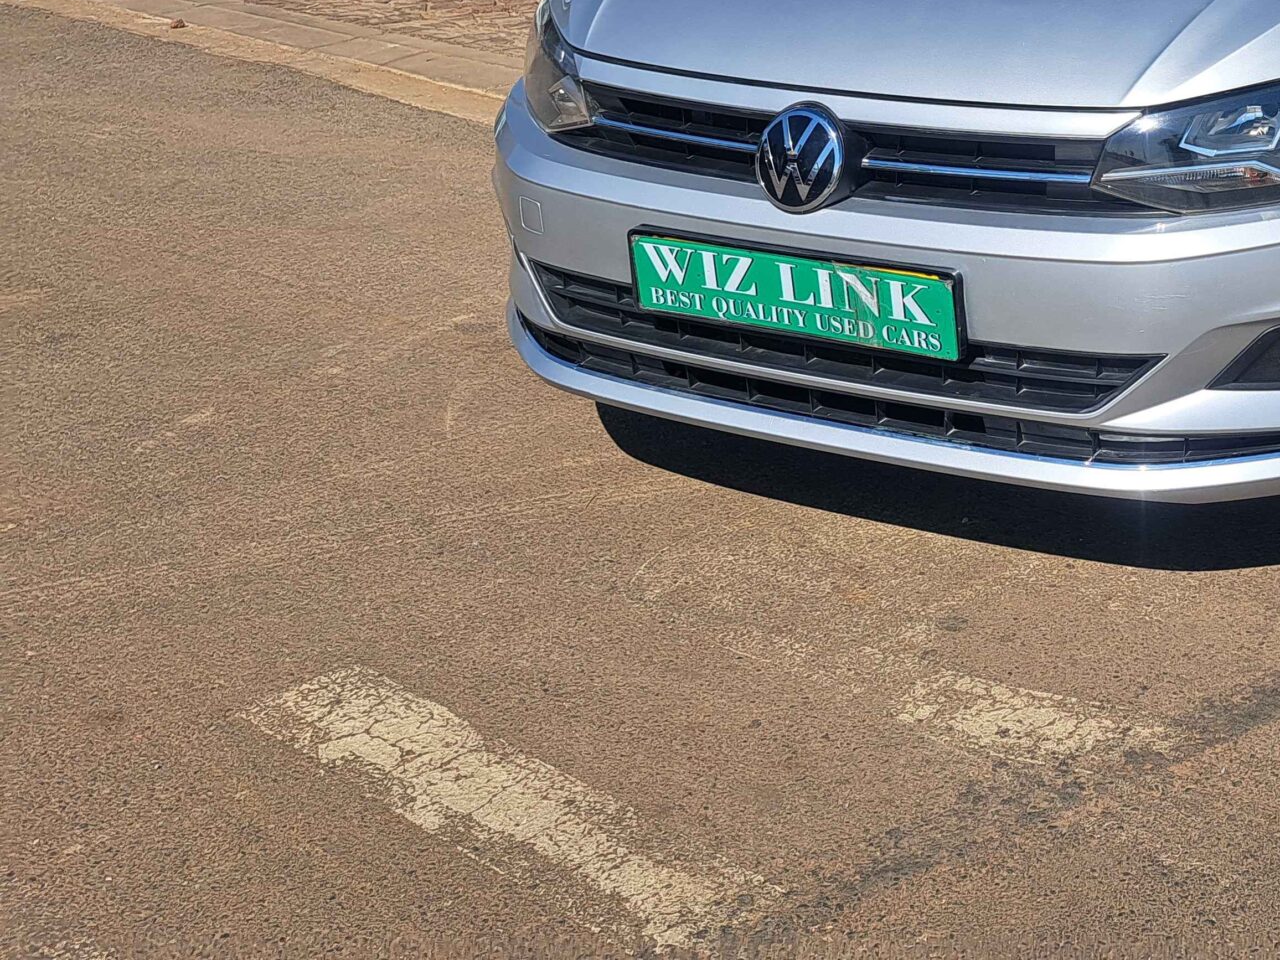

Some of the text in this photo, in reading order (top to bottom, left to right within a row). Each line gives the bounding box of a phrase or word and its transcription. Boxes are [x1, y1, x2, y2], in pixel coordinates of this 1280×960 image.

[639, 242, 937, 328] WIZ LINK
[650, 287, 942, 352] BEST QUALITY USED CARS
